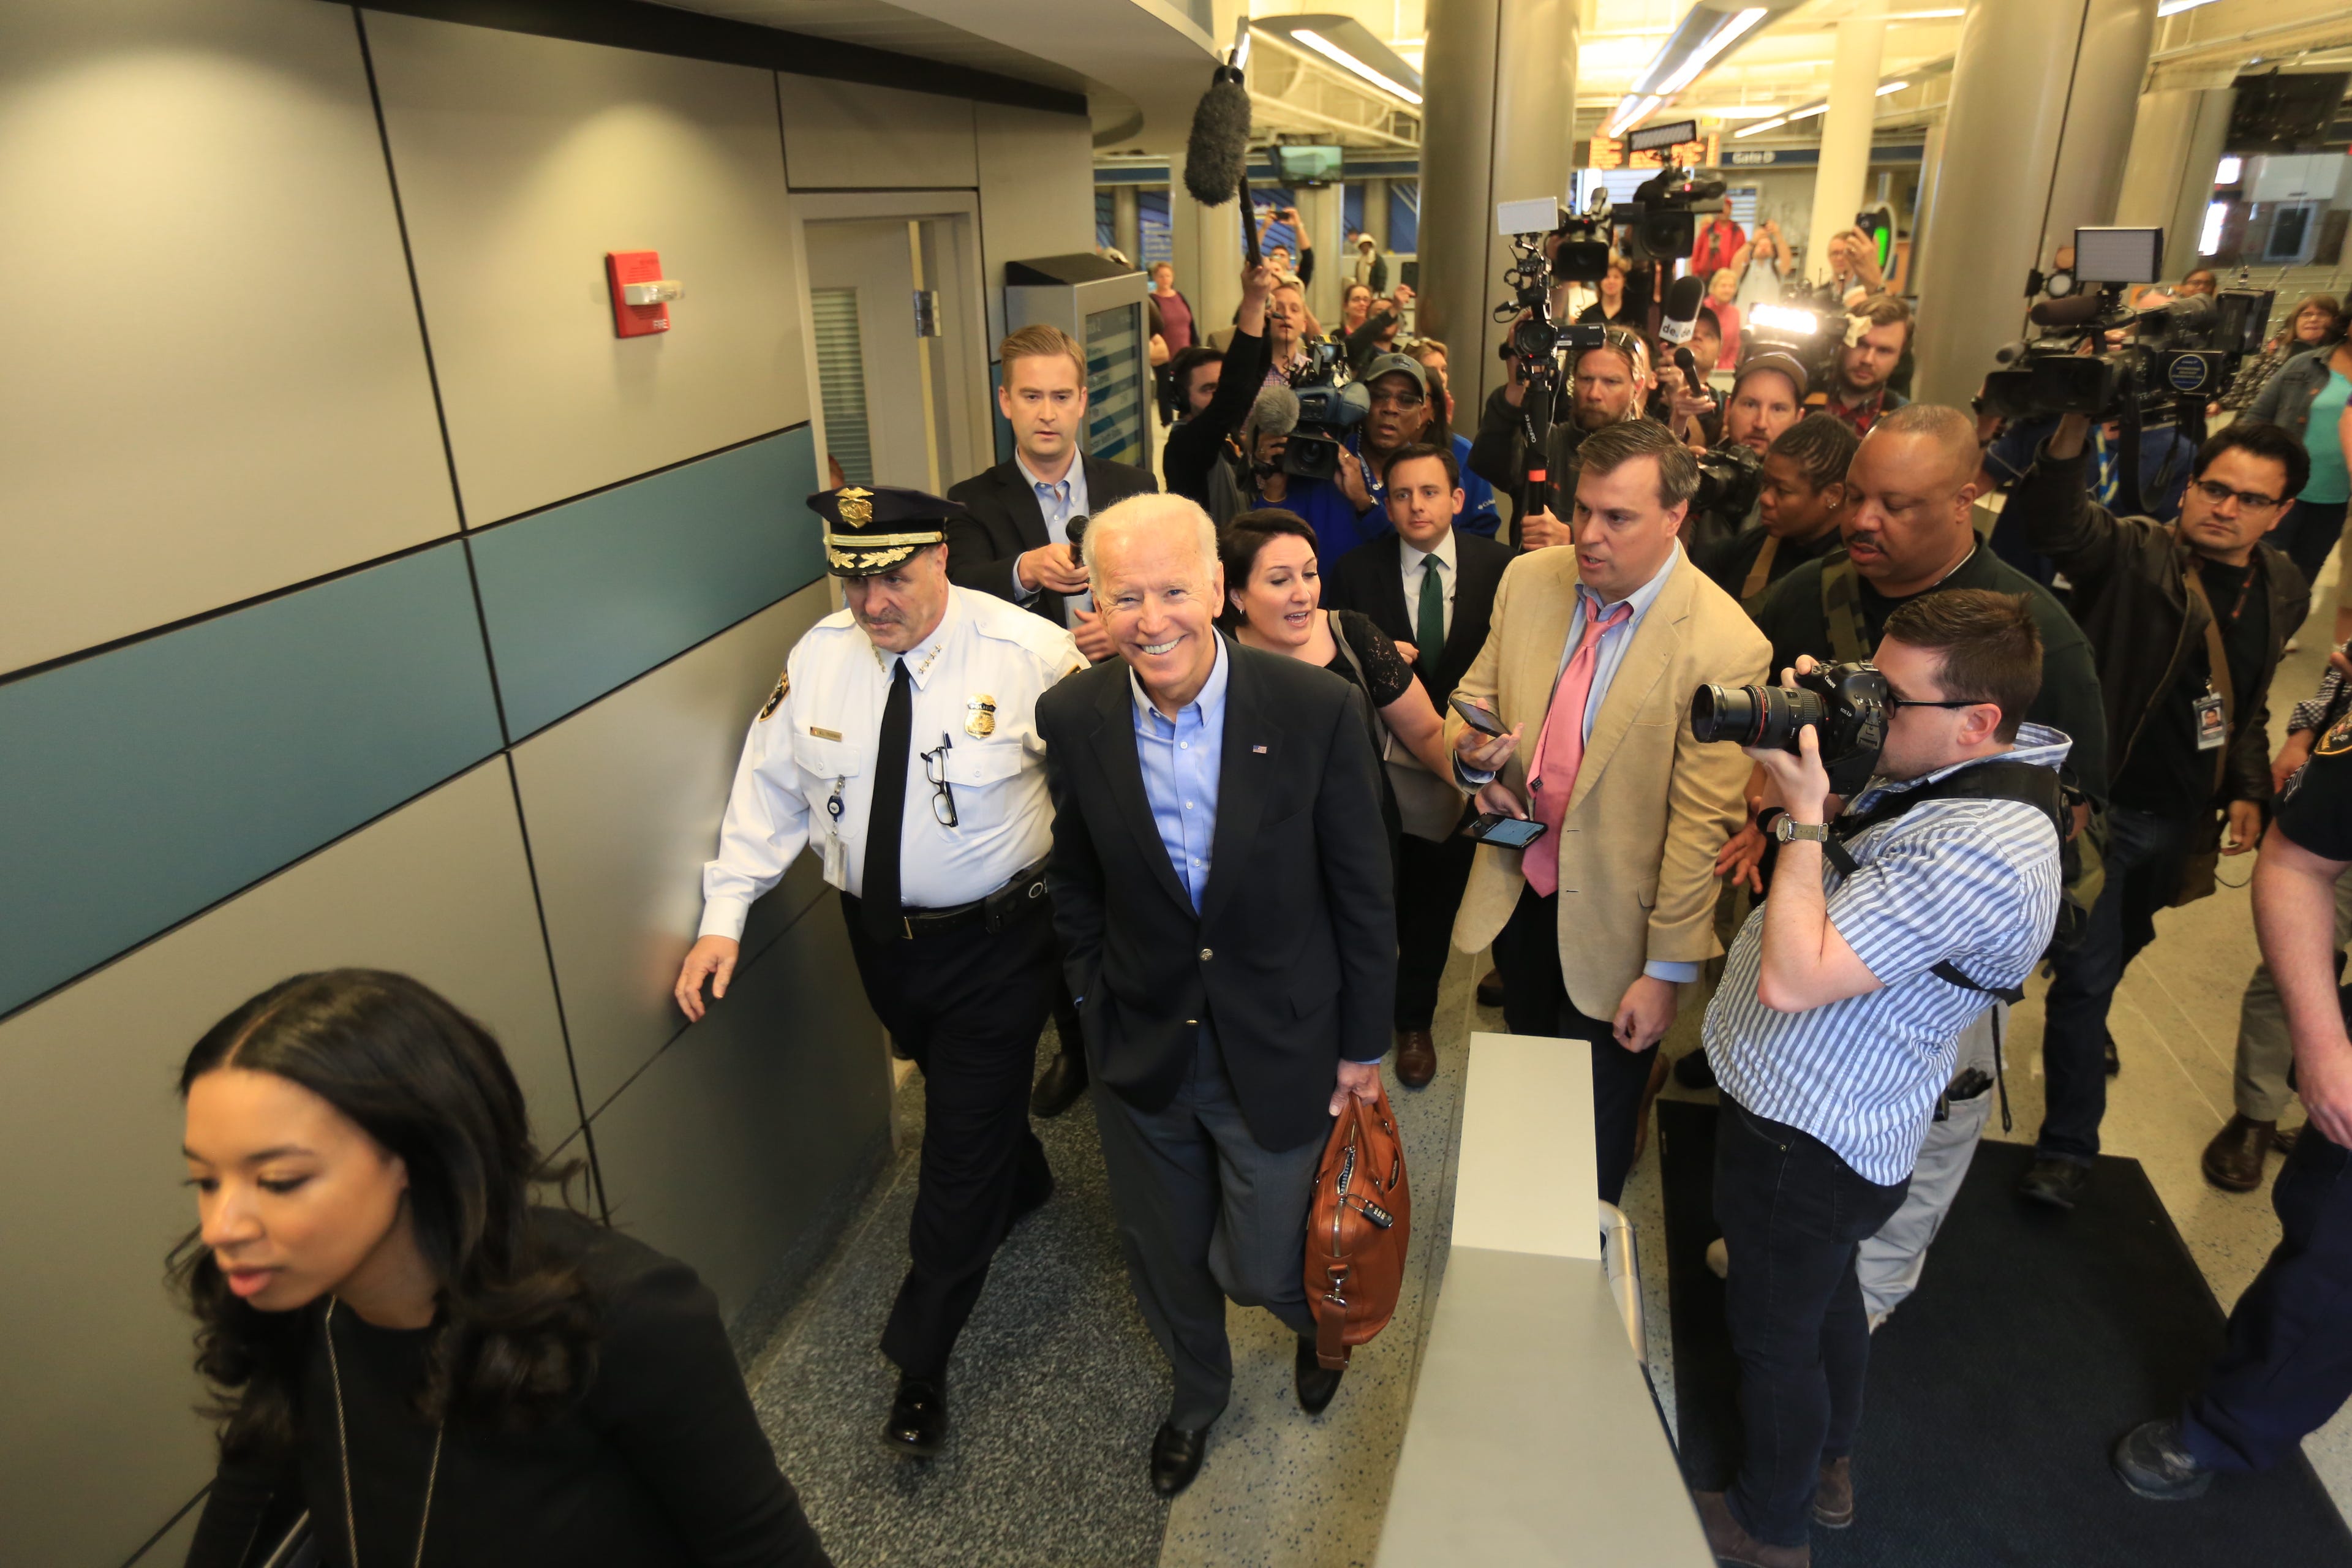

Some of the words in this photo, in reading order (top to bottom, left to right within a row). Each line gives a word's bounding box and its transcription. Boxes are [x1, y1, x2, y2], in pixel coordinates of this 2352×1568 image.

[1732, 151, 1763, 164] Gate
[653, 318, 669, 329] FIRE
[1824, 675, 1836, 688] Canon
